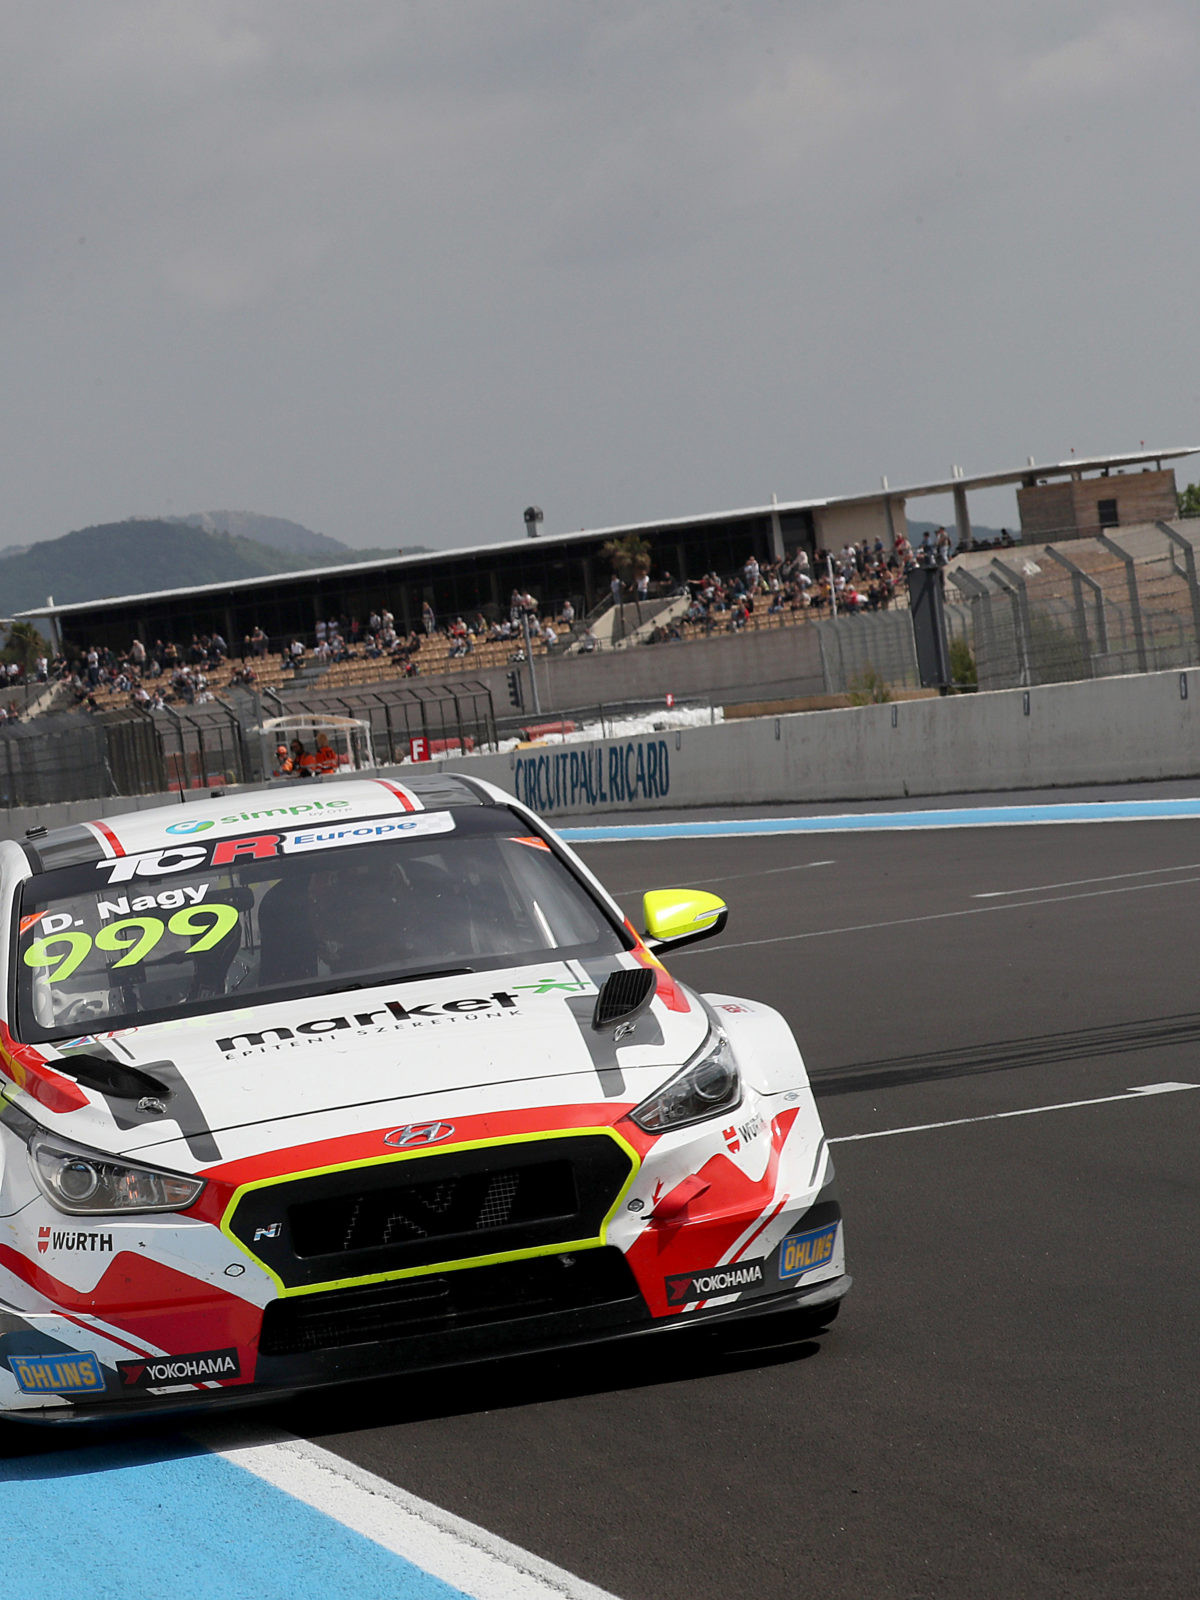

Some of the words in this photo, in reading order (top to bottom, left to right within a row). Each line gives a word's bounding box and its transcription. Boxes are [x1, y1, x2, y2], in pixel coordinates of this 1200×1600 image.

[411, 739, 424, 761] F
[515, 754, 569, 811] CIRCUIT
[570, 748, 607, 806] PAUL
[609, 740, 670, 802] RICARD
[220, 800, 349, 824] simple
[96, 835, 281, 884] TCR
[294, 821, 418, 845] Europe
[40, 913, 84, 935] D.
[97, 883, 210, 919] Nagy
[23, 903, 239, 985] 999
[215, 991, 519, 1053] market
[52, 1231, 113, 1252] WÜRTH
[784, 1234, 834, 1272] ÖHLINS
[693, 1265, 763, 1294] YOKOHAMA
[16, 1358, 96, 1389] ÖHLINS
[145, 1355, 236, 1381] YOKOHAMA
